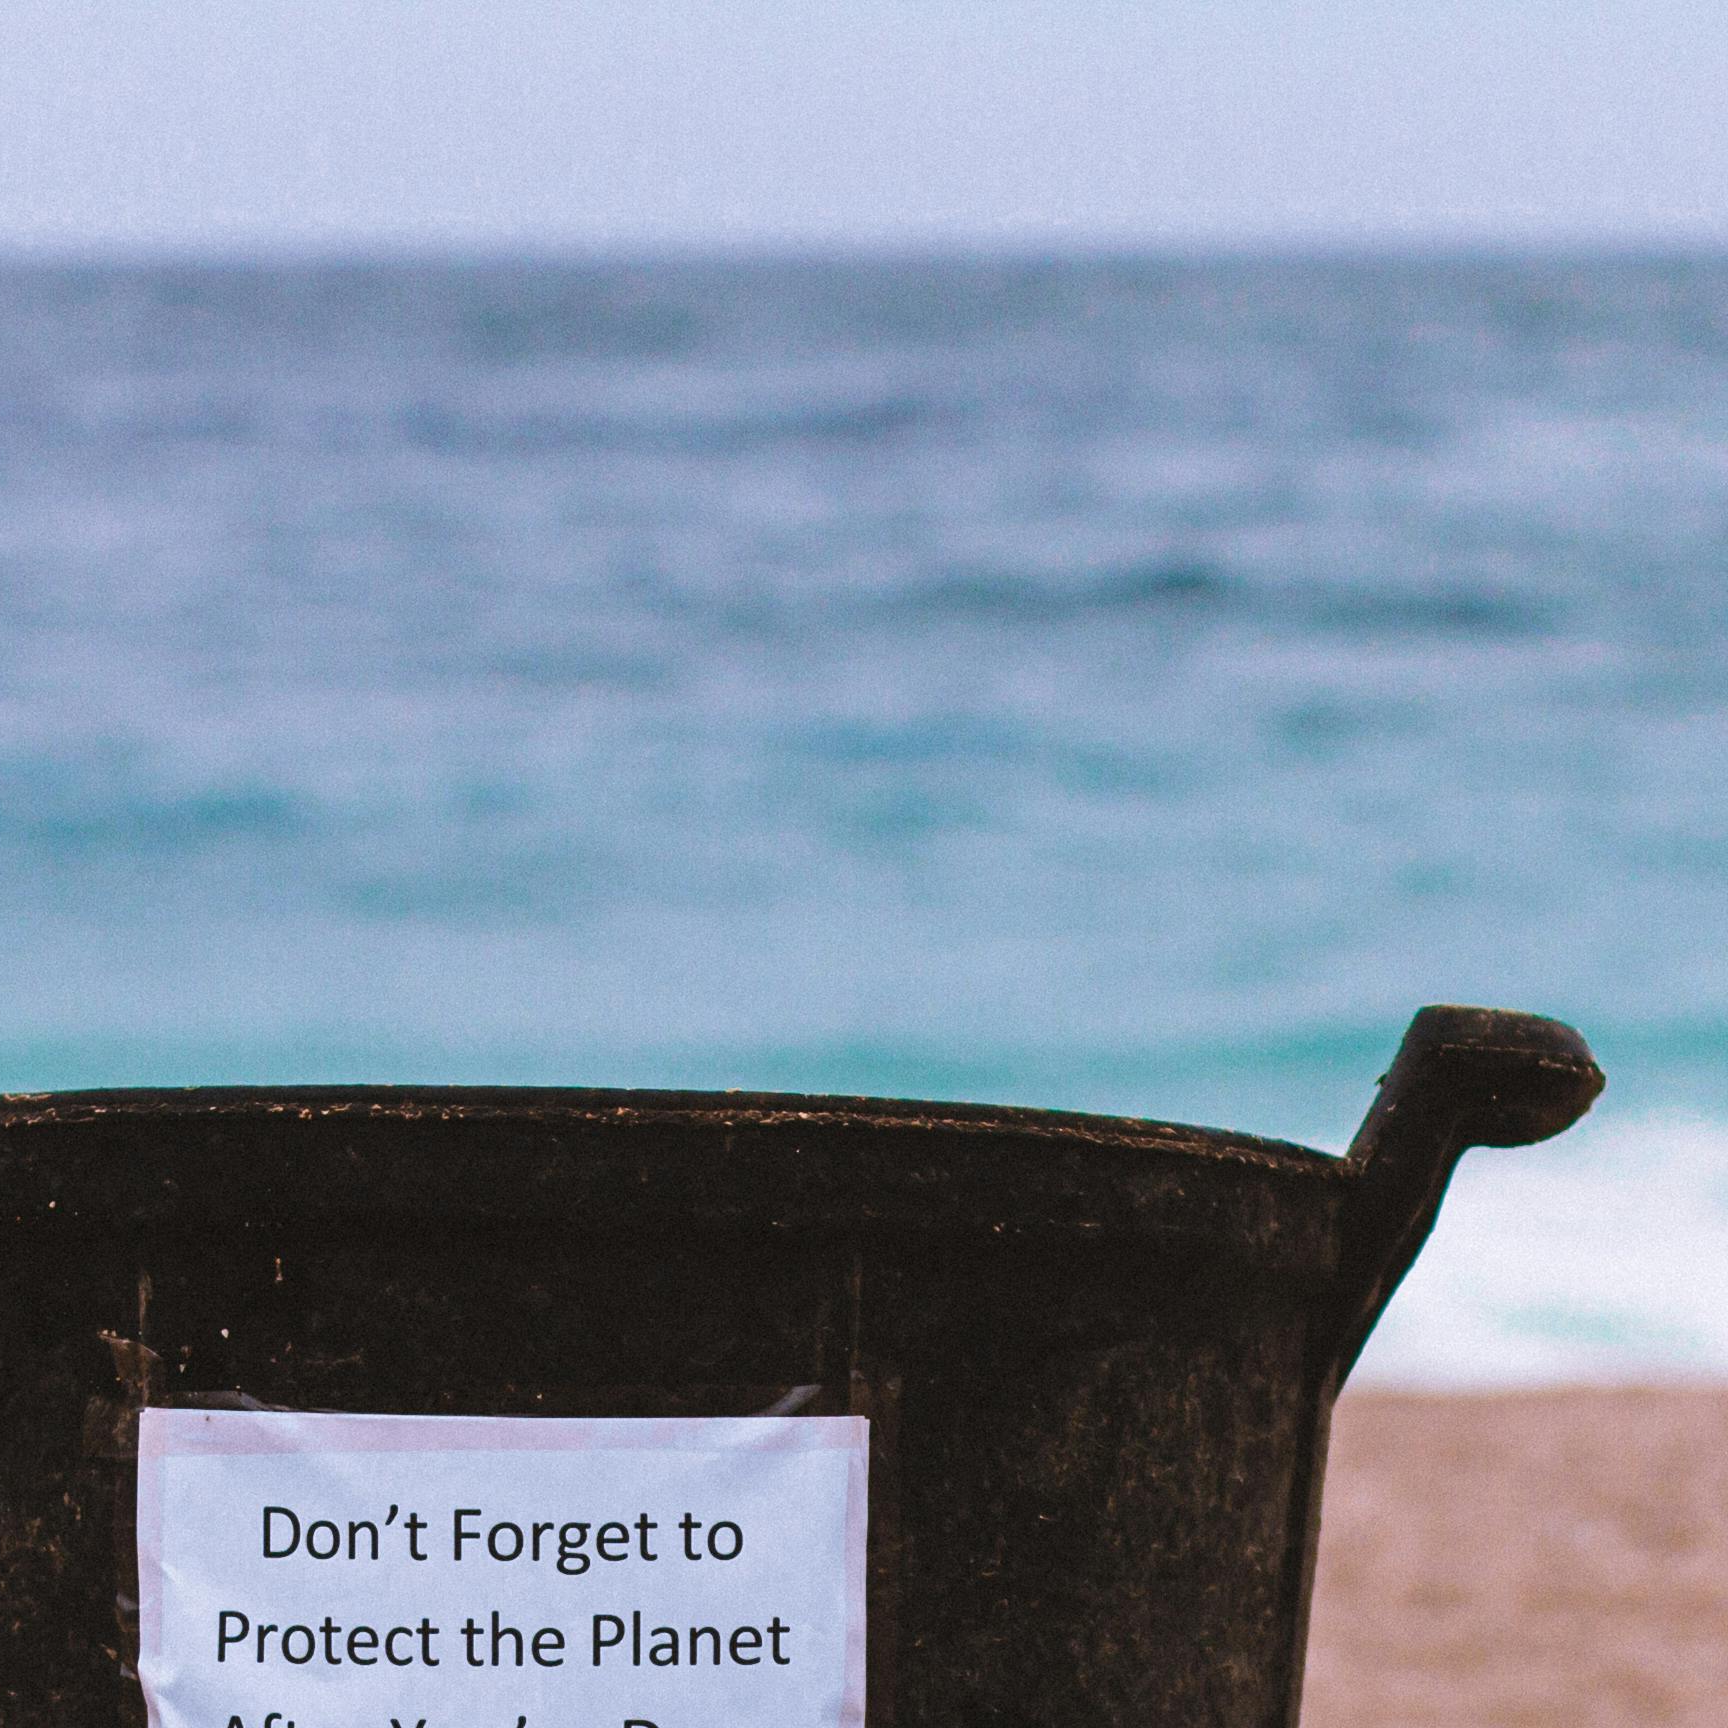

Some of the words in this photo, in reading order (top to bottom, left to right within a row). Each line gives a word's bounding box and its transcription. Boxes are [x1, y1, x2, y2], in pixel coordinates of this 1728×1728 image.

[261, 1502, 429, 1563] Don’t
[452, 1507, 659, 1577] Forget
[677, 1511, 745, 1563] to
[216, 1609, 441, 1668] Protect
[459, 1609, 567, 1669] the
[591, 1609, 792, 1668] Planet
